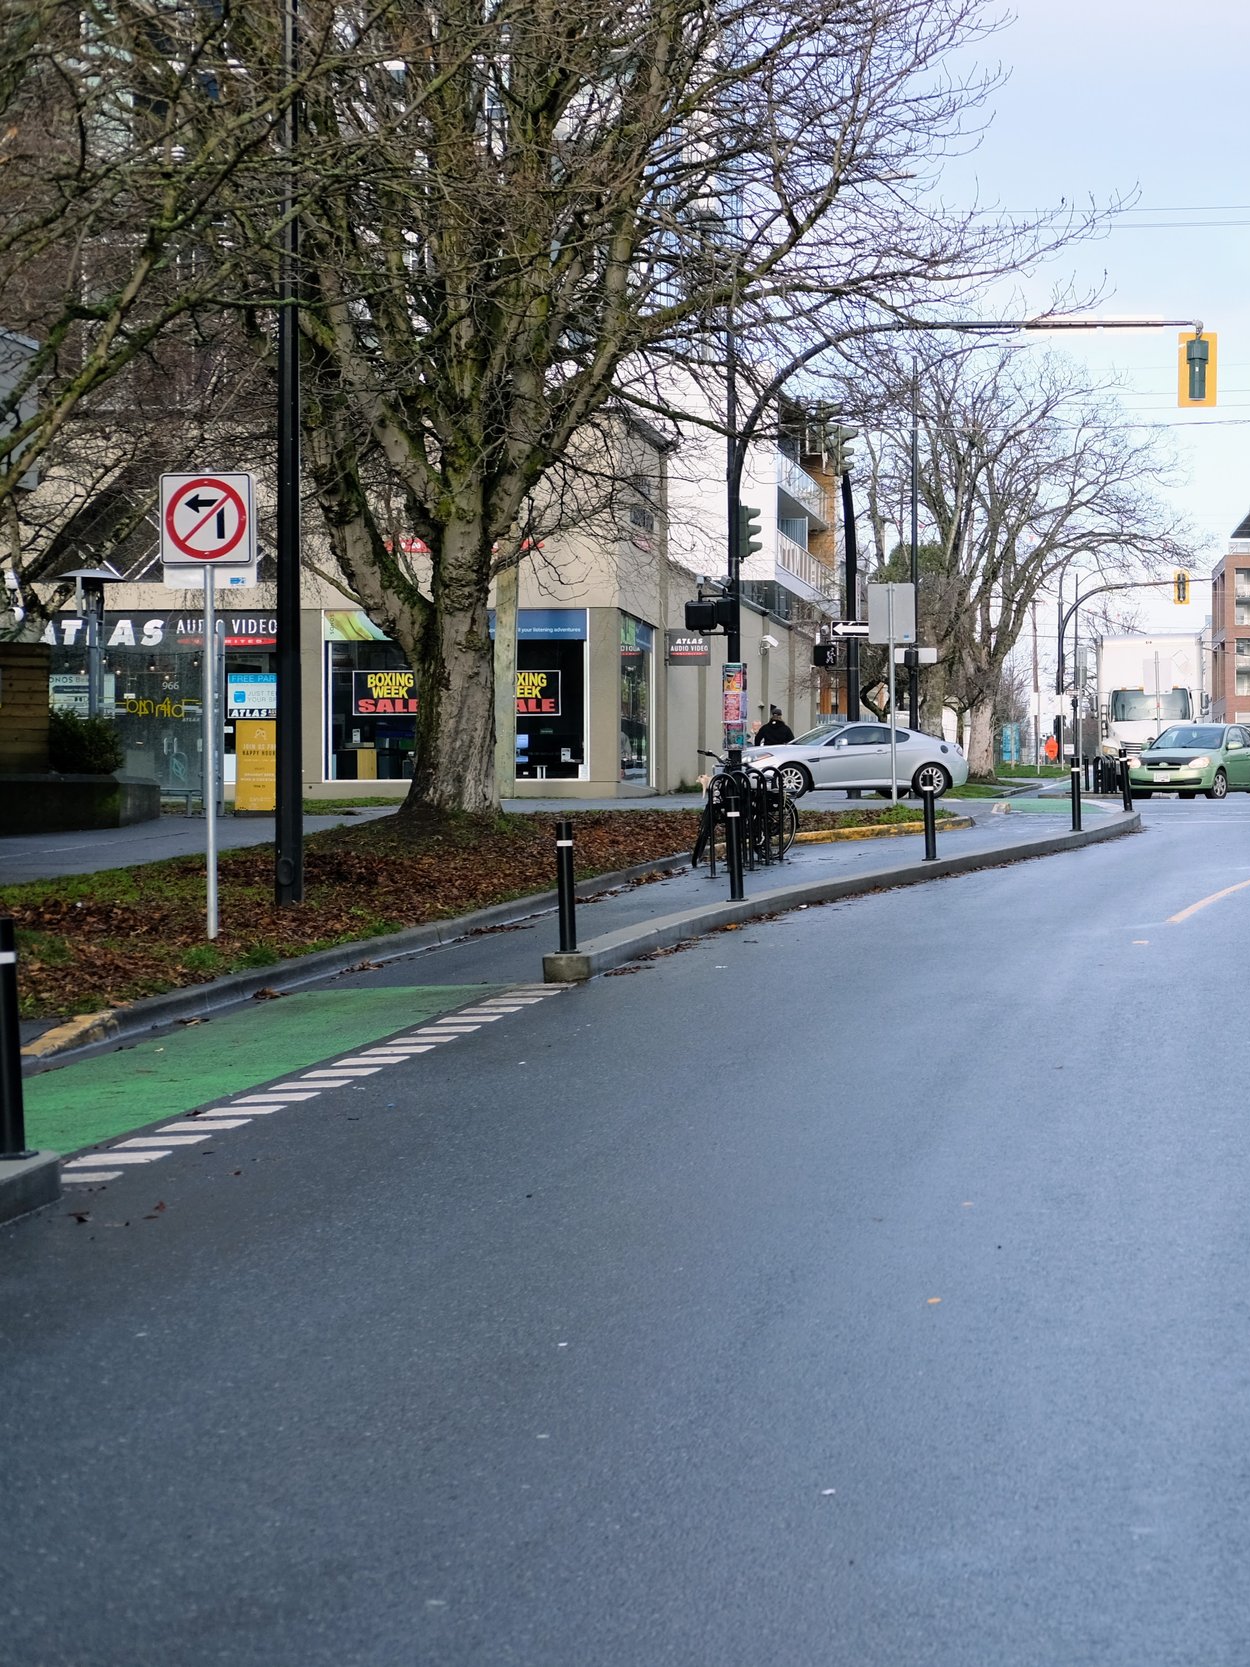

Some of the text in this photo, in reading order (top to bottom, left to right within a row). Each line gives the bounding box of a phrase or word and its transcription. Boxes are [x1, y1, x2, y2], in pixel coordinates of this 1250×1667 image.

[231, 619, 277, 634] VIDEO
[162, 681, 180, 690] 966
[231, 675, 254, 683] FREE
[367, 672, 415, 688] BOXING
[371, 686, 409, 699] WEEK
[516, 685, 542, 699] EEK
[358, 698, 419, 713] SALE
[516, 698, 556, 712] ALE
[230, 709, 268, 717] ATLAS
